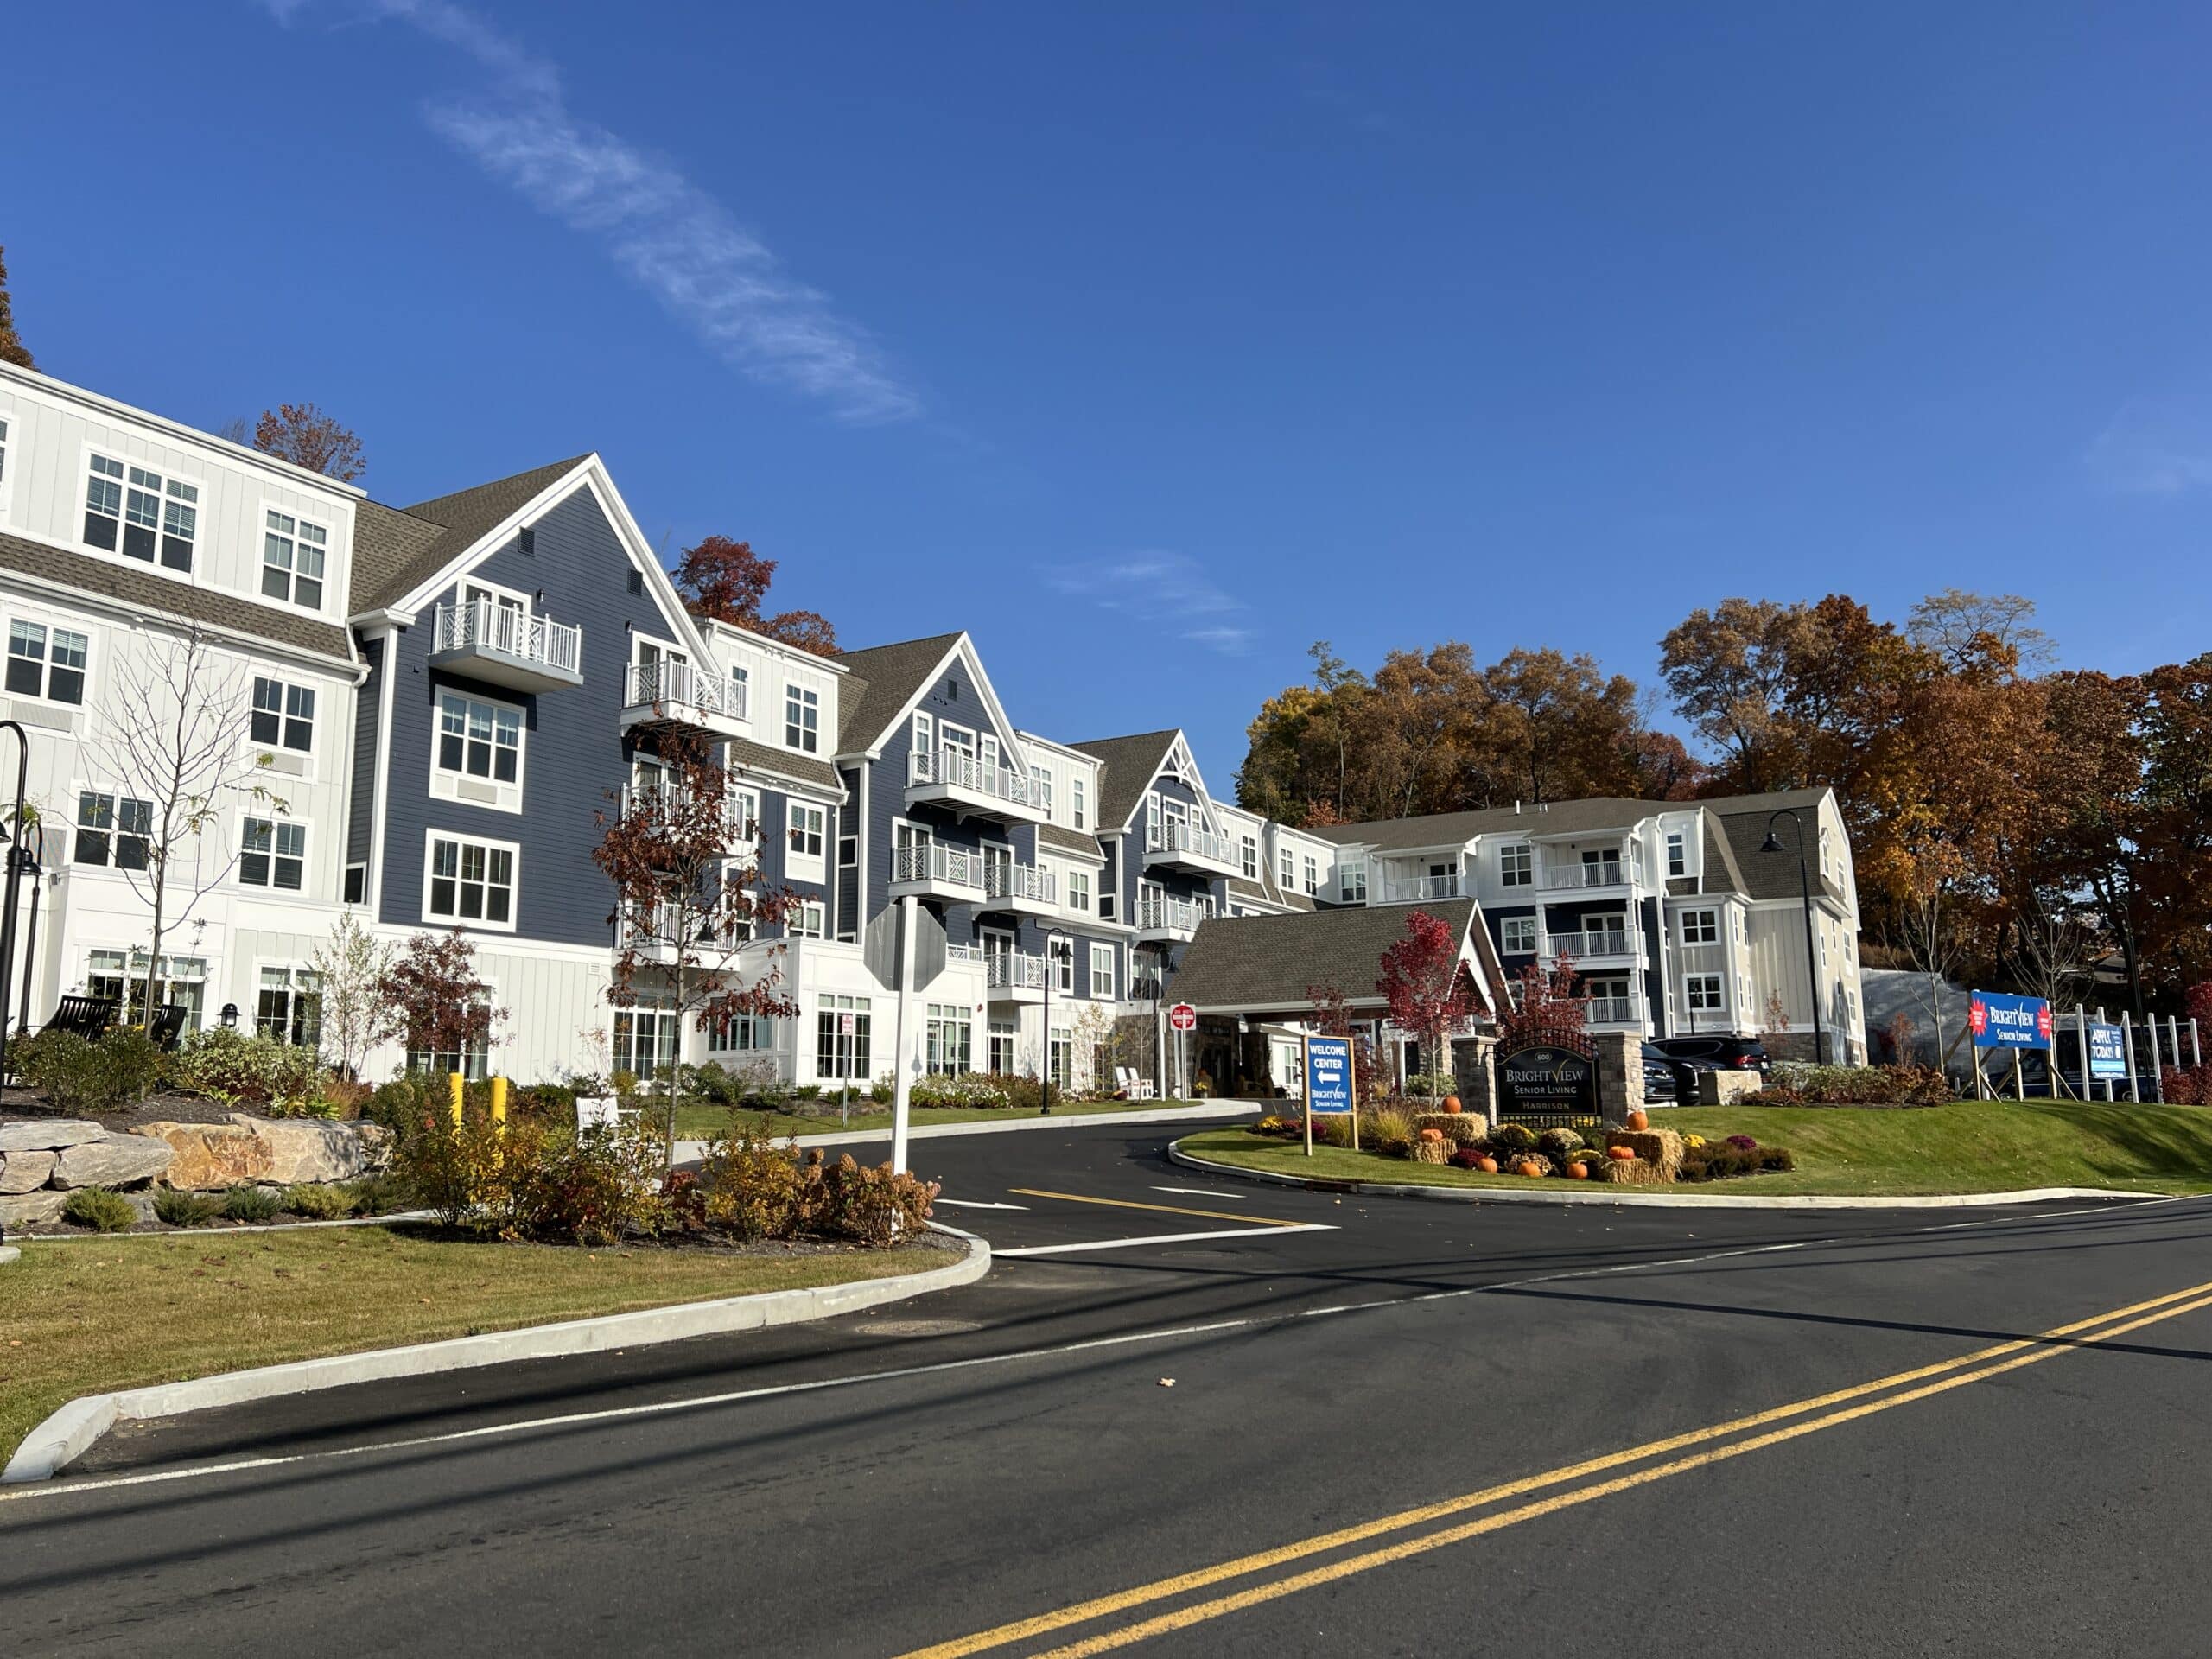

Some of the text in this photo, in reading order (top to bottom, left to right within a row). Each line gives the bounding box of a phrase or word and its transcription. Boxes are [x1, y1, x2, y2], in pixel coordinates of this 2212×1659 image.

[1996, 1028, 2033, 1043] SENIOR LIVING
[2092, 1029, 2112, 1045] APPLY
[1309, 1045, 1346, 1056] WELCOME
[1313, 1058, 1343, 1070] CENTER
[1514, 1084, 1577, 1095] SENIOR LIVING
[1522, 1102, 1570, 1110] HARRISON
